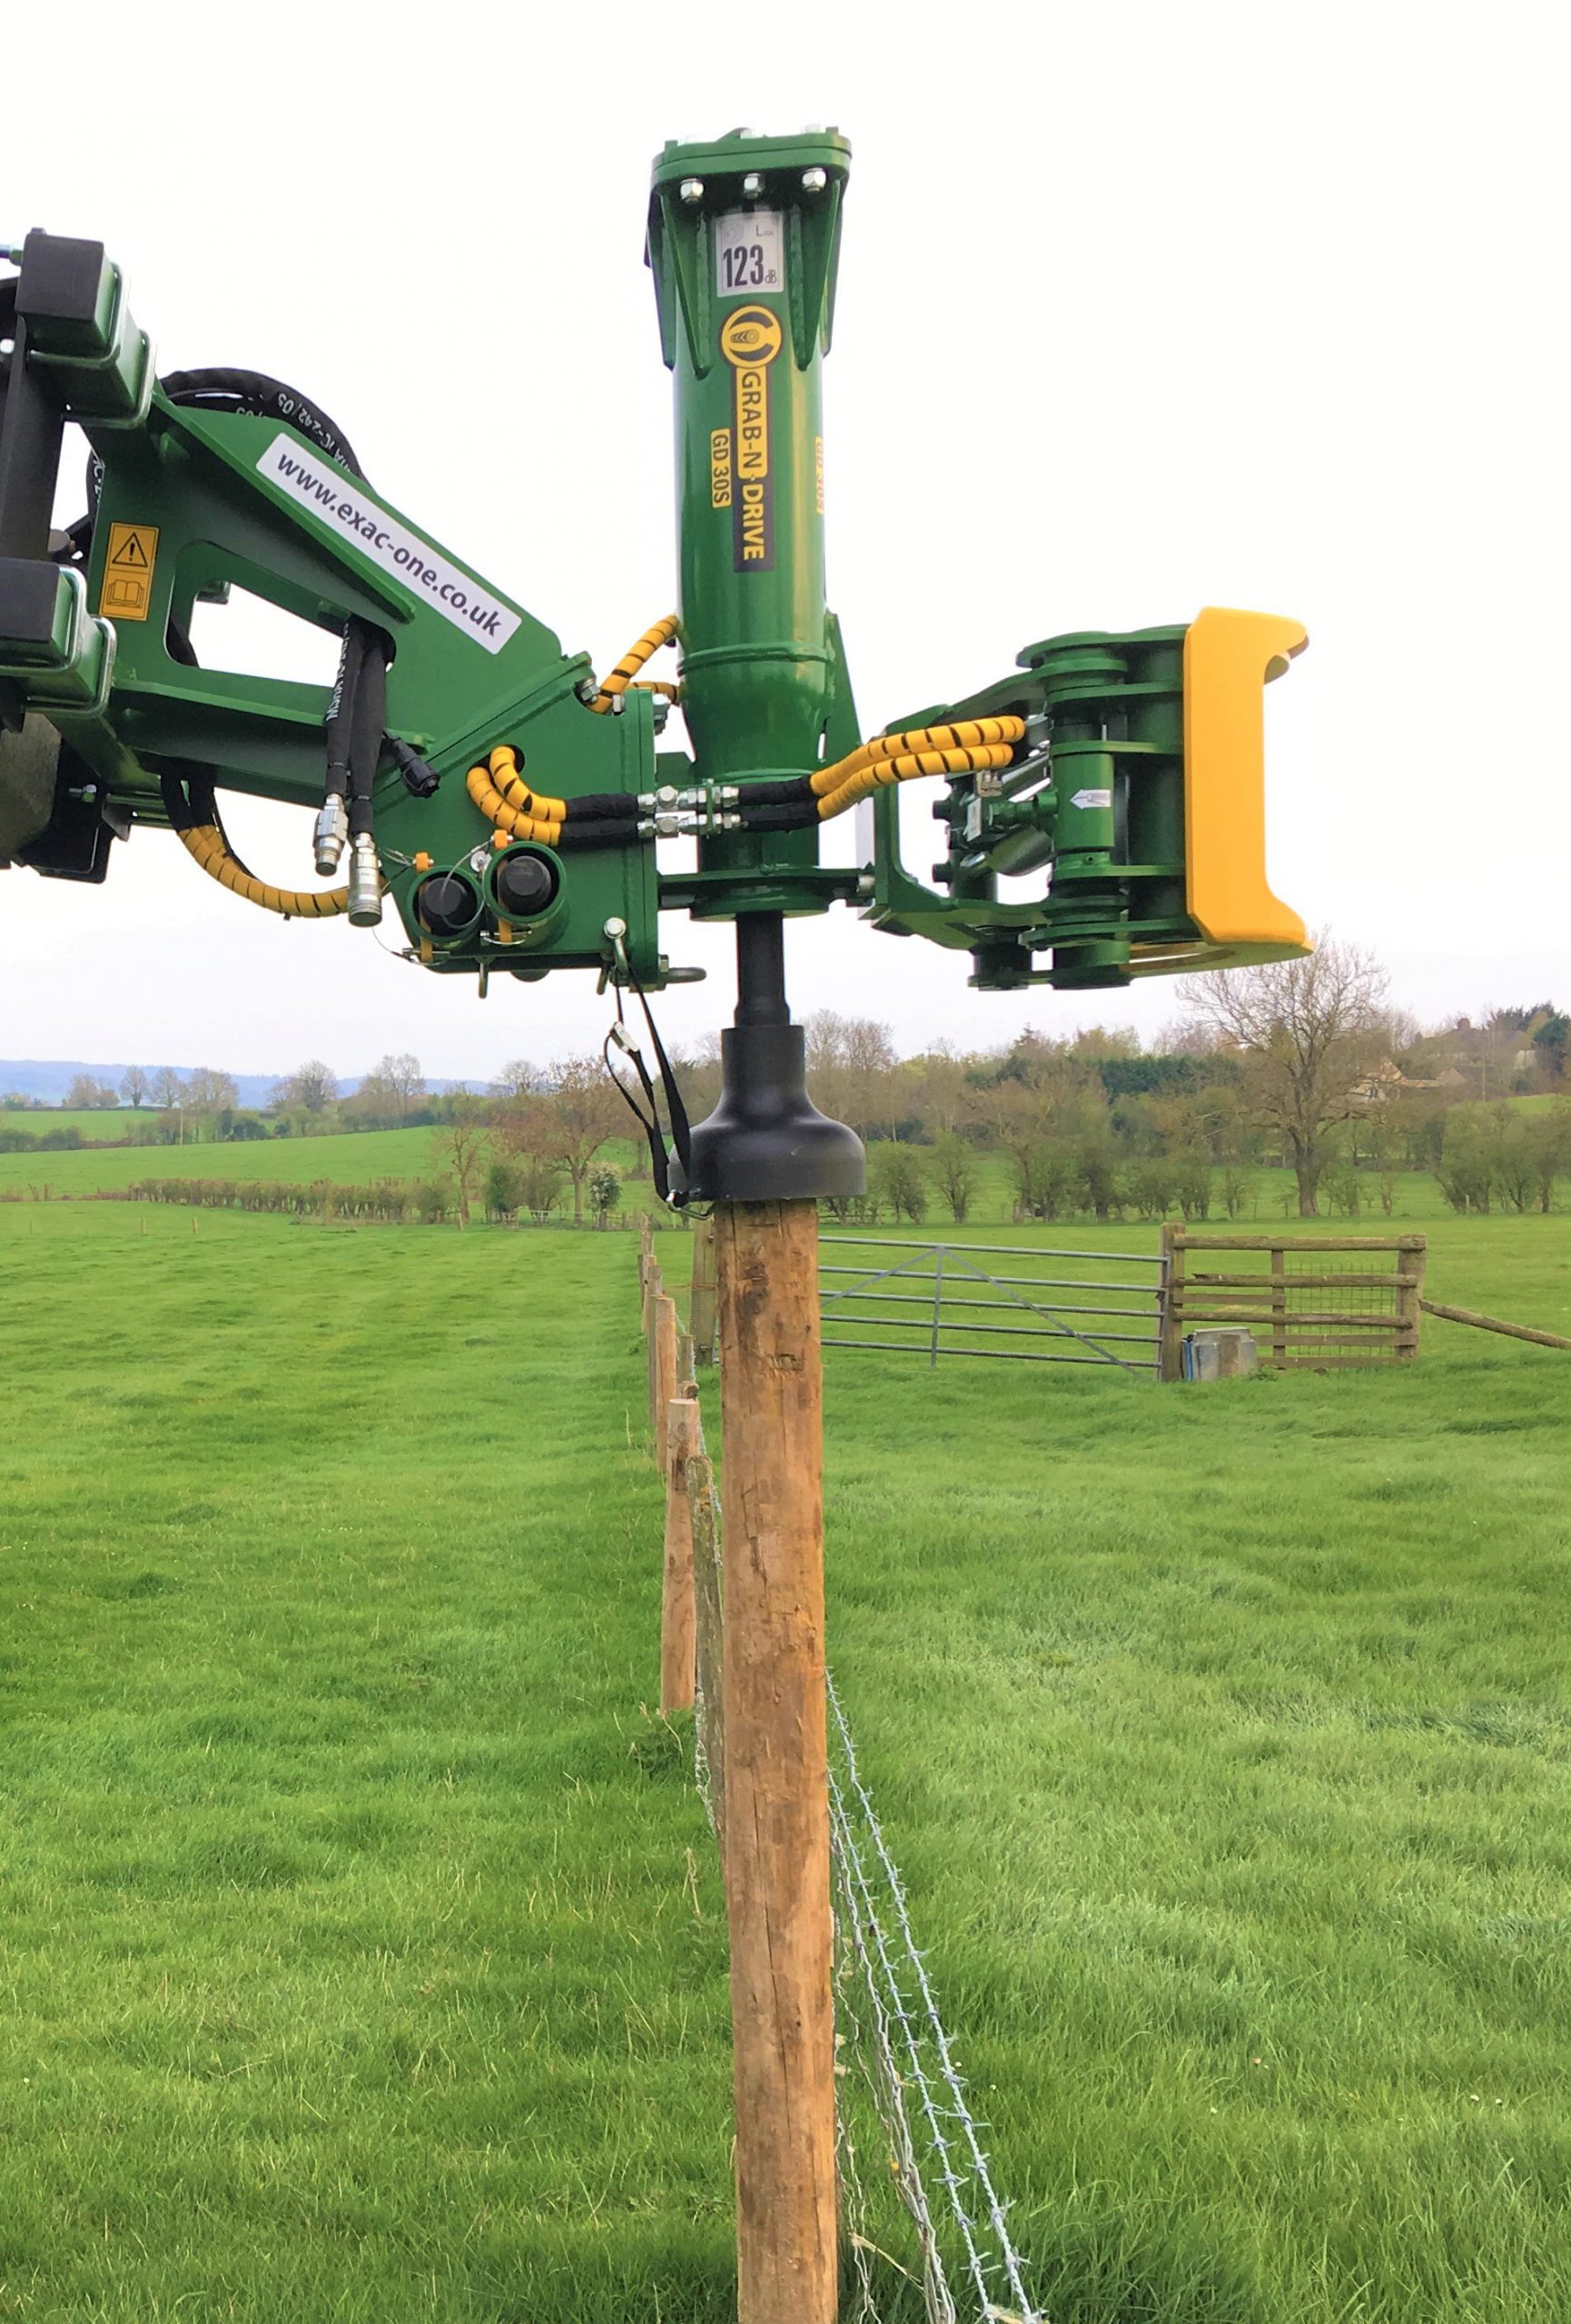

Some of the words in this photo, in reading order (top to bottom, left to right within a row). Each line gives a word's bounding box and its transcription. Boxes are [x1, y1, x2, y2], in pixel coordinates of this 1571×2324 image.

[723, 244, 764, 287] 123
[765, 269, 778, 284] dB
[713, 434, 728, 461] GD
[713, 468, 730, 504] 30S
[277, 454, 501, 636] www.exac-one.co.uk
